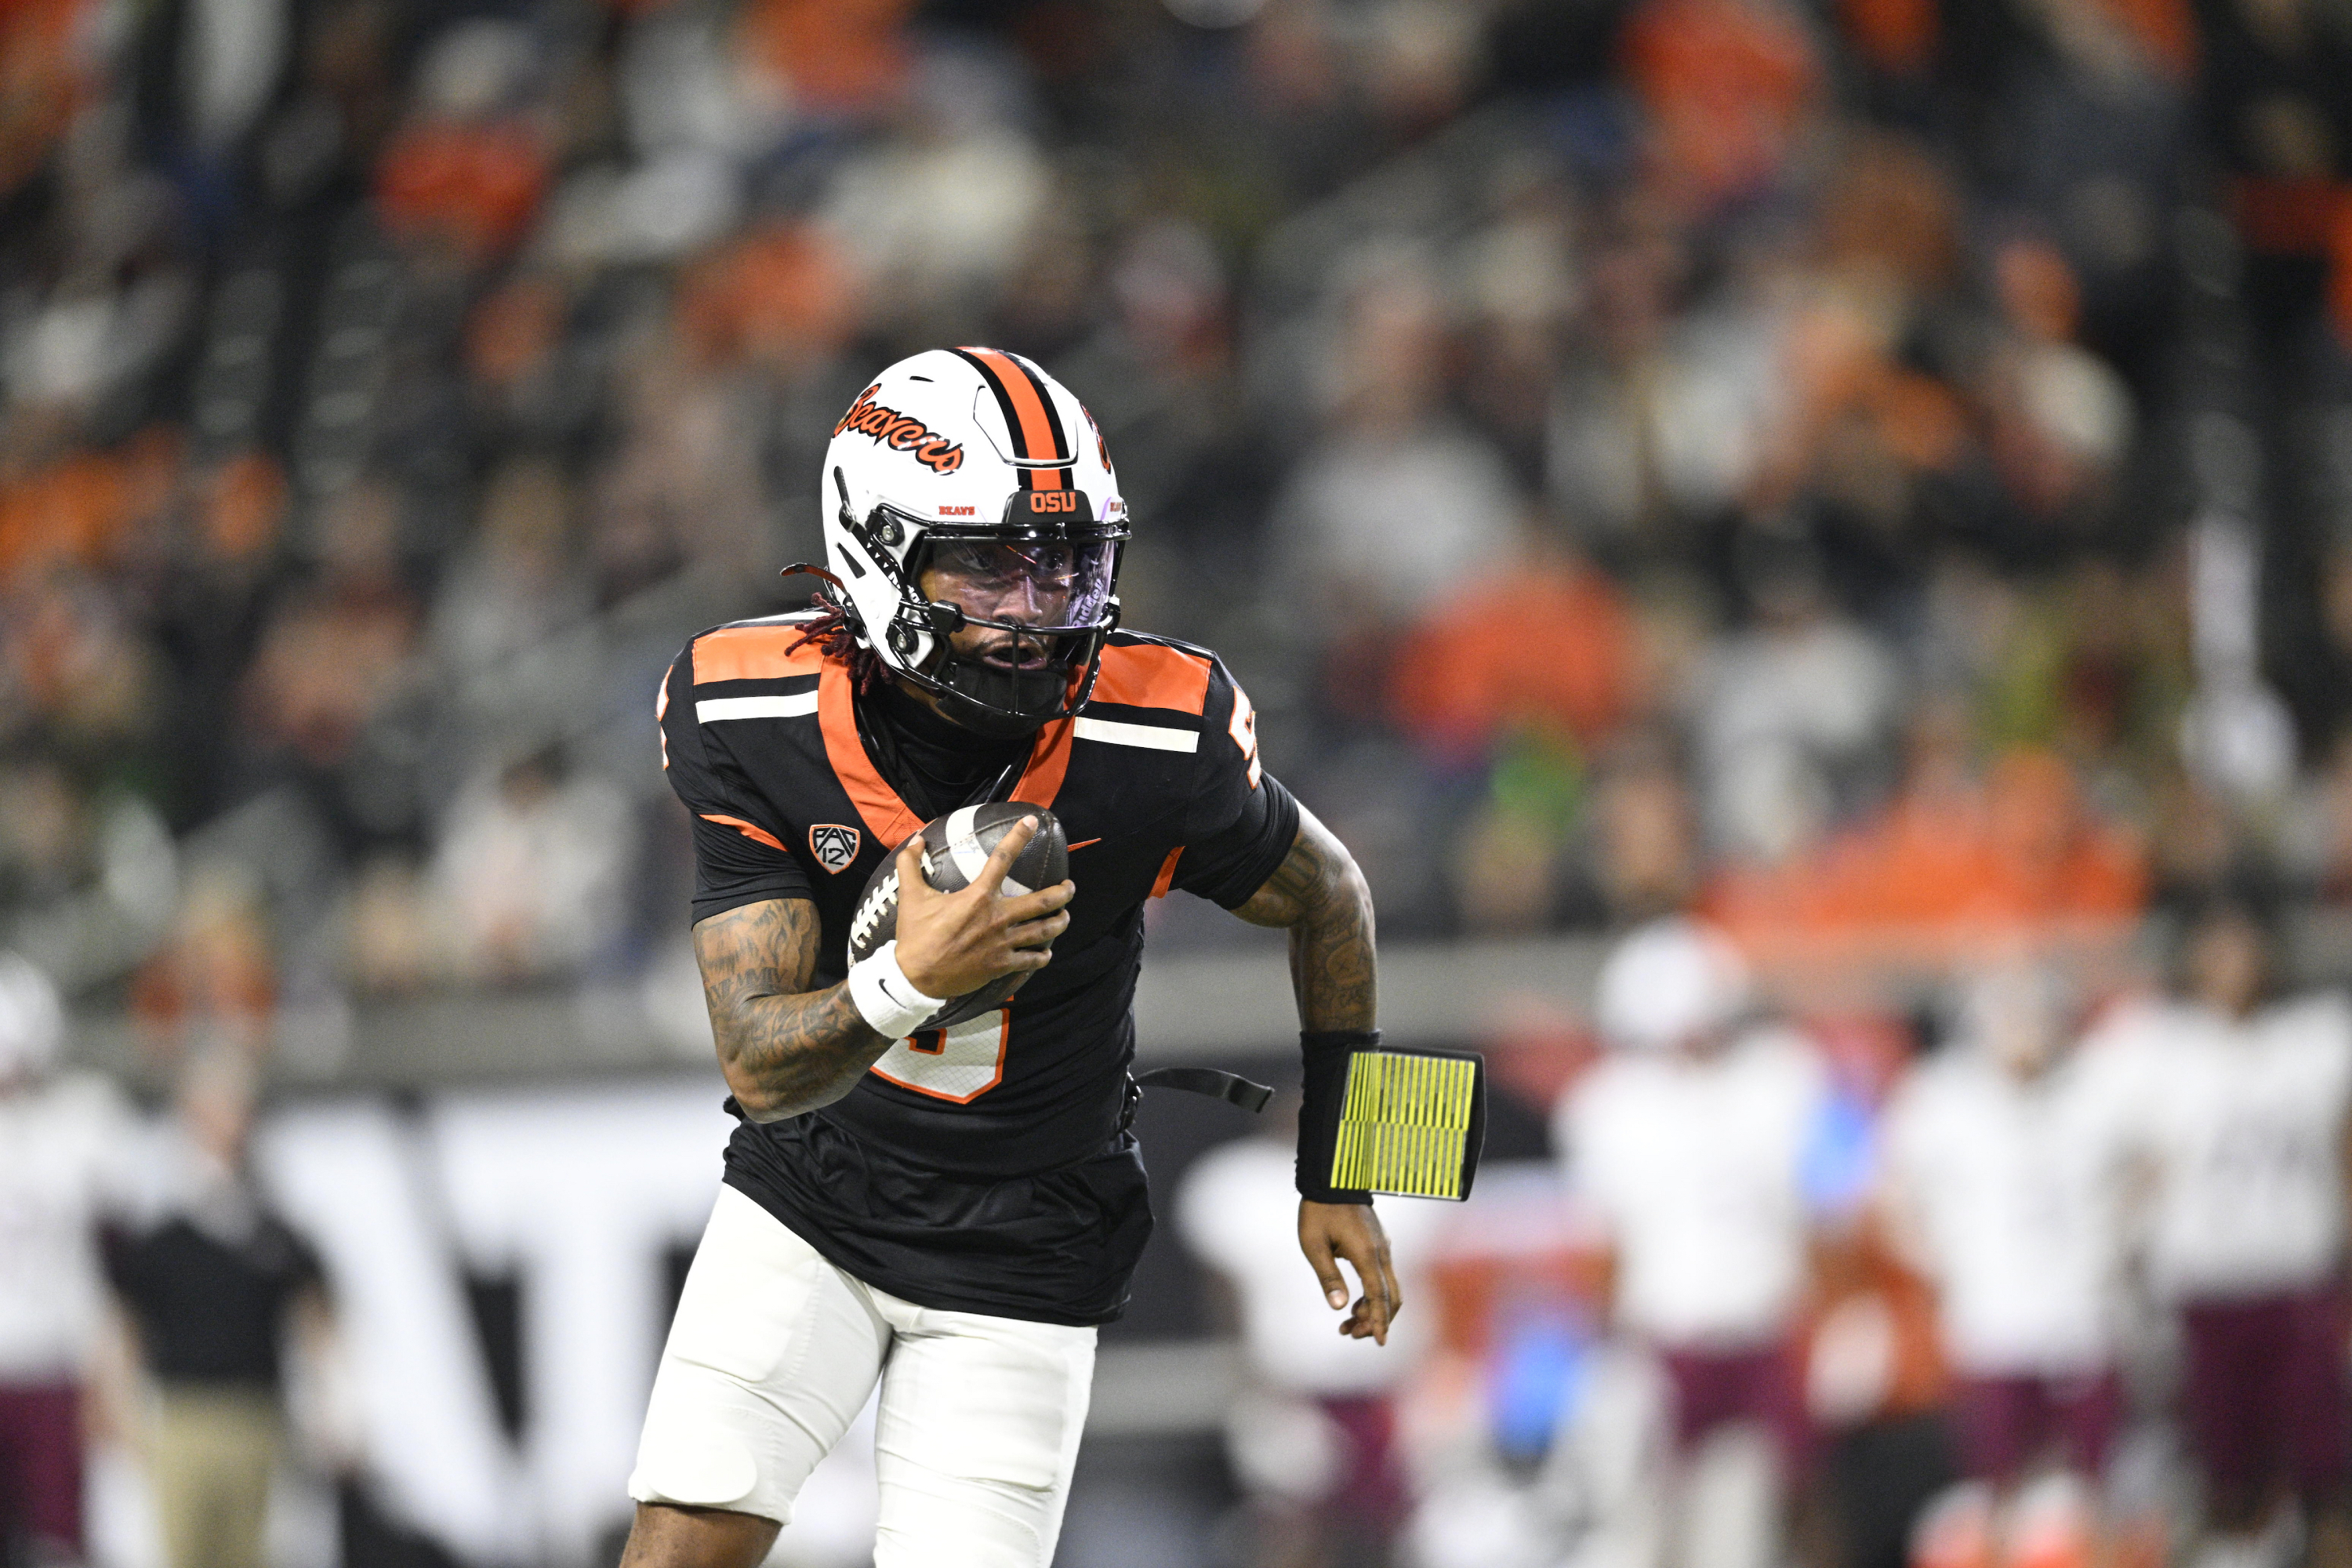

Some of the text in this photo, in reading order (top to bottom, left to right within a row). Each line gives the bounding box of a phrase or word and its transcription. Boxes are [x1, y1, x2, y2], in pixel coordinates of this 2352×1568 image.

[833, 383, 964, 475] Beavers
[938, 506, 975, 516] BEAVS
[1030, 492, 1076, 513] OSU
[812, 827, 857, 858] PAC
[822, 848, 845, 866] 12
